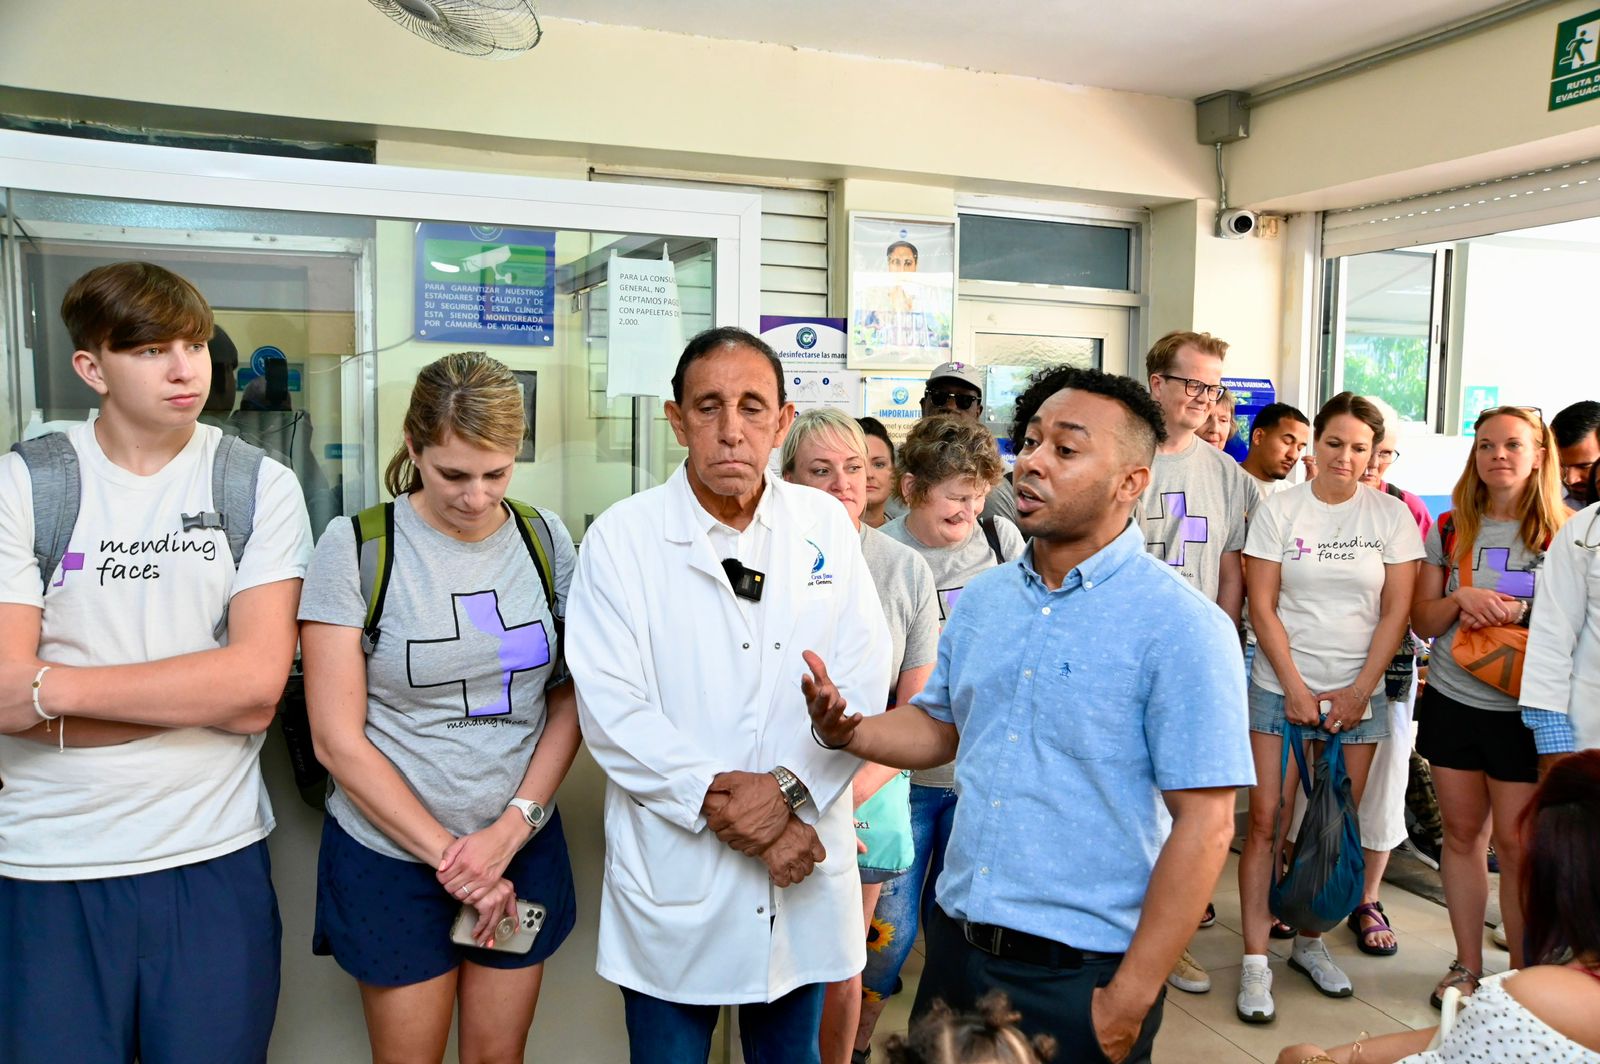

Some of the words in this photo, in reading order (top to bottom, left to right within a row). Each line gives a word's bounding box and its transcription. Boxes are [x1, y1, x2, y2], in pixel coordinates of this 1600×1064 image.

[1566, 77, 1592, 90] RUTA
[1594, 74, 1600, 82] D
[620, 273, 638, 281] PARA
[650, 276, 676, 284] CONSU
[424, 283, 445, 291] PARA
[451, 284, 500, 294] GARANTIZAR
[506, 288, 544, 296] NUESTROS
[619, 284, 652, 293] GENERAL,
[490, 295, 522, 304] CALIDAD
[534, 298, 544, 306] DE
[619, 295, 662, 305] ACEPTAMOS
[441, 302, 486, 312] SEGURIDAD,
[636, 308, 673, 317] PAPELETAS
[450, 312, 480, 320] SIENDO
[485, 314, 544, 323] MONITOREADA
[502, 324, 544, 332] VIGILANCIA
[779, 350, 820, 359] desinfectarse
[100, 531, 216, 561] mending
[1317, 536, 1382, 551] mending
[1316, 549, 1355, 562] faces
[96, 557, 160, 586] faces
[446, 718, 498, 729] mending
